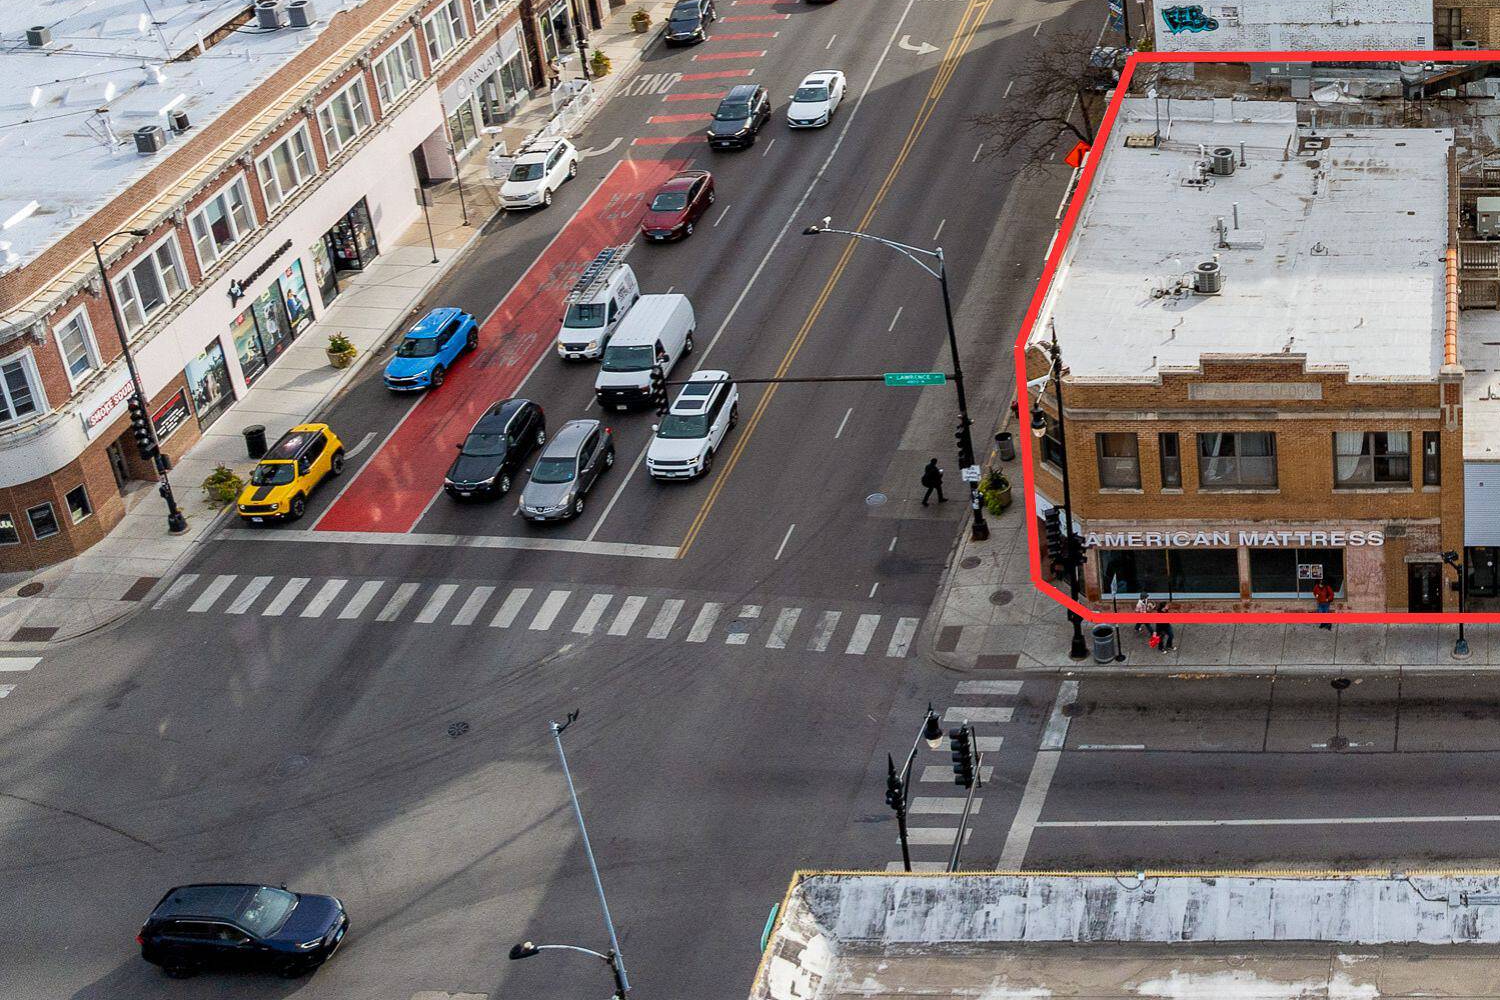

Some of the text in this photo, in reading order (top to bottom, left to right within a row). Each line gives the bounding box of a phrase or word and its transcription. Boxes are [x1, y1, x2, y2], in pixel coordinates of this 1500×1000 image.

[614, 72, 683, 97] ONLY
[89, 397, 116, 426] SMOKE
[1081, 530, 1385, 547] AMERICAN MATTRESS
